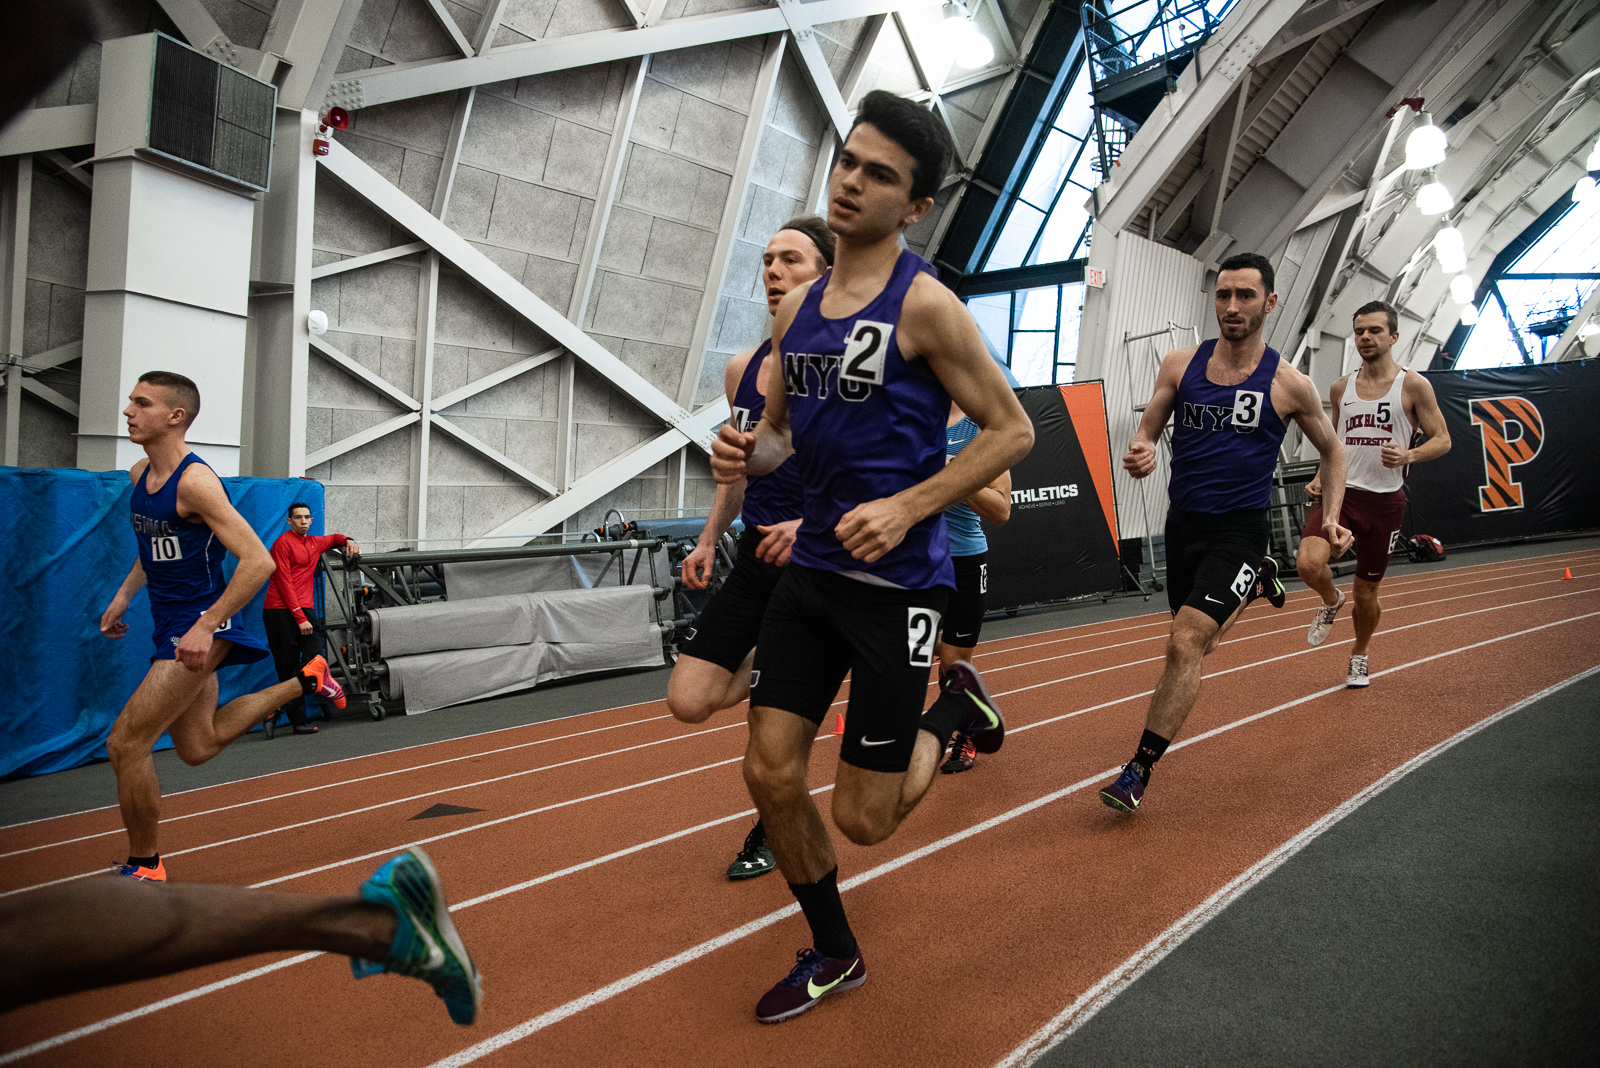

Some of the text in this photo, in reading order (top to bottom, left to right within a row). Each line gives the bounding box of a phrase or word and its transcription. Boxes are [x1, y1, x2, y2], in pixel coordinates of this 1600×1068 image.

[845, 325, 881, 381] 2
[1182, 402, 1255, 434] NY
[1235, 393, 1257, 424] 3
[1376, 402, 1391, 424] 5
[1345, 414, 1393, 434] LOCK HAEN
[1345, 436, 1393, 446] UNIVERSITY
[1468, 395, 1545, 513] P
[153, 538, 176, 560] 10
[1236, 569, 1254, 598] 3
[909, 612, 932, 663] 2
